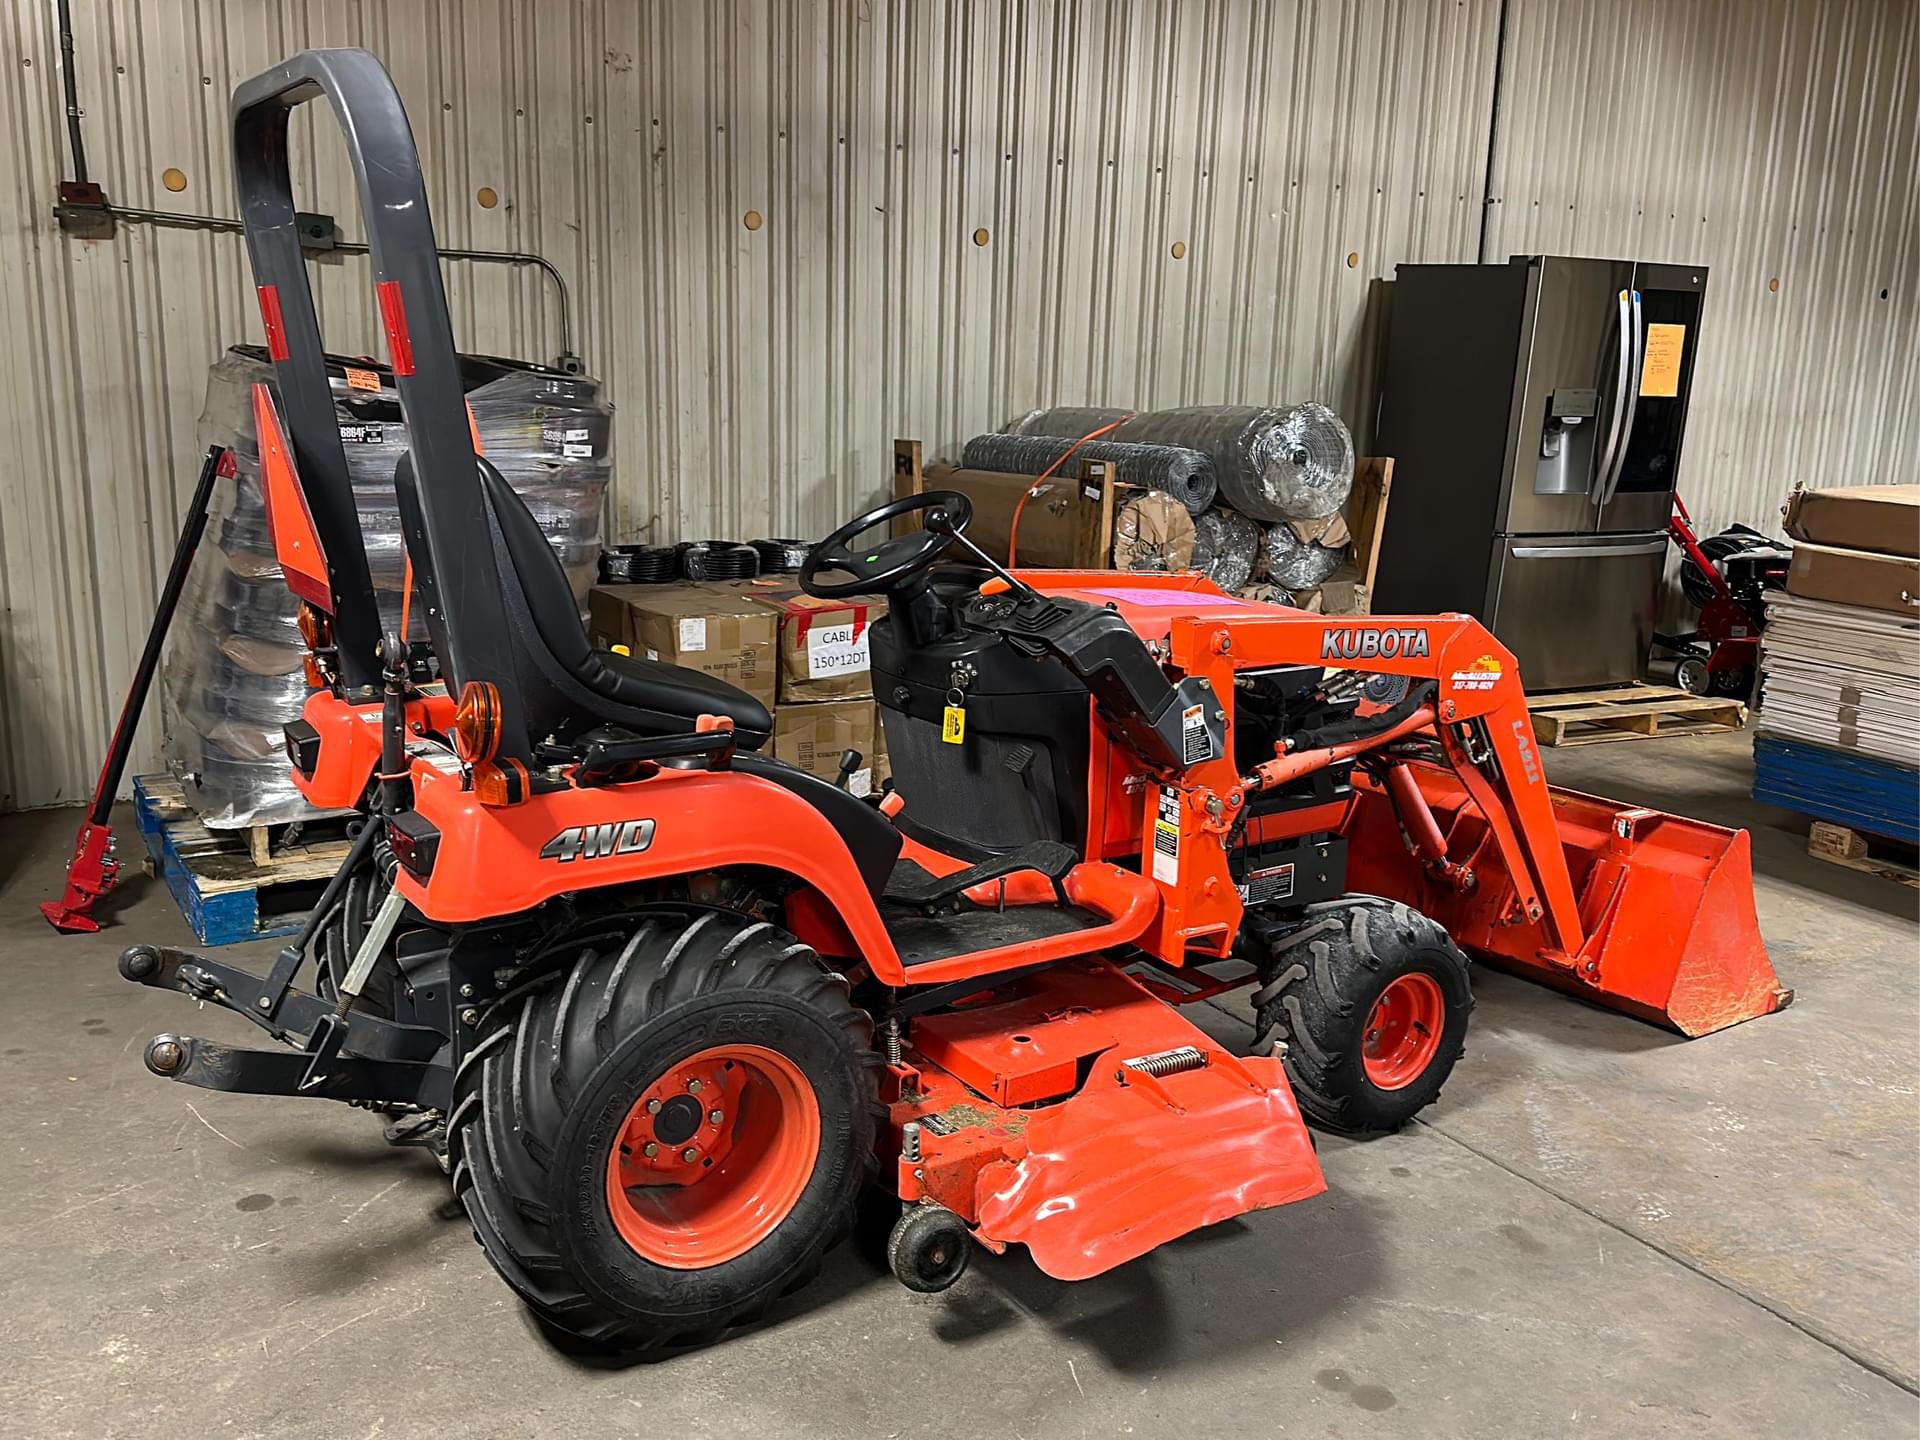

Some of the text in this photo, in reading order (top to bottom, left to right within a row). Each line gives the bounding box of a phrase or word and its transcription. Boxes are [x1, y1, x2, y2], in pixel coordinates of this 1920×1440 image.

[822, 630, 851, 644] CABL
[1321, 628, 1429, 658] KUBOTA
[539, 818, 656, 863] 4WD
